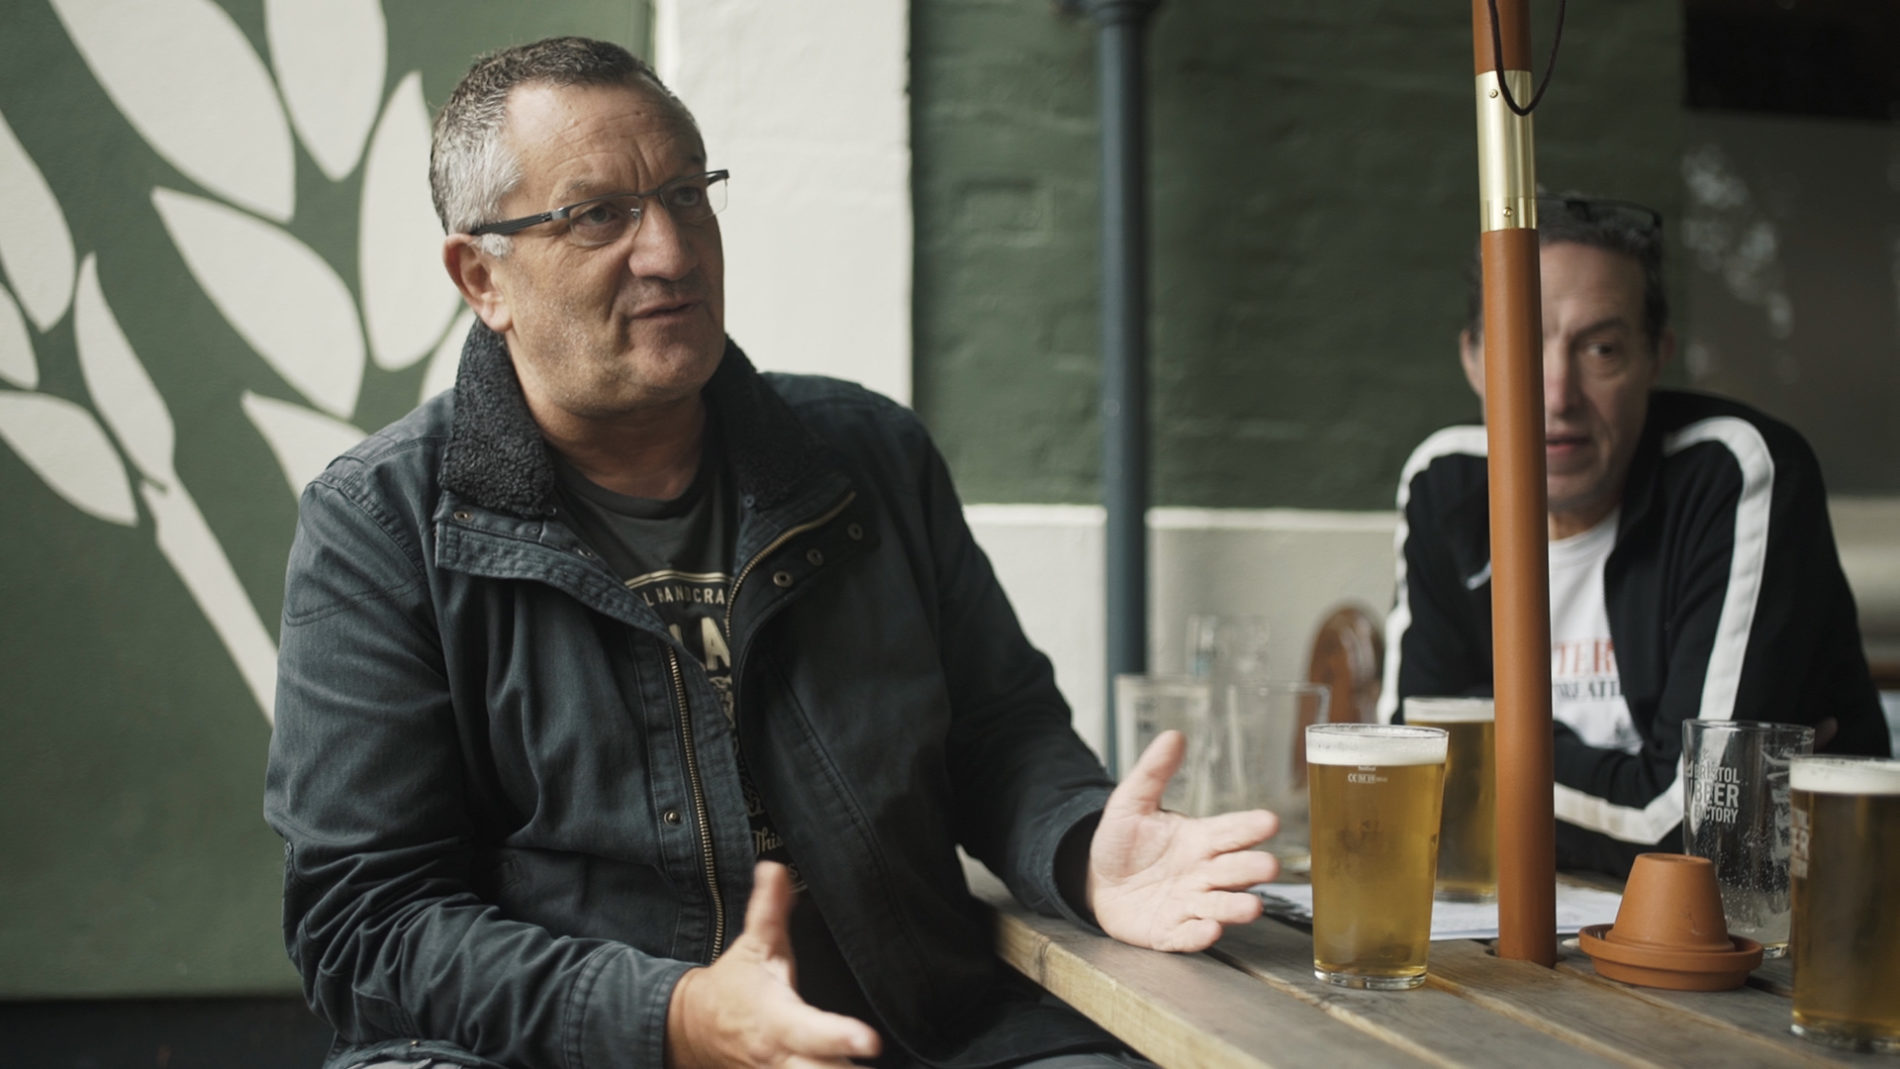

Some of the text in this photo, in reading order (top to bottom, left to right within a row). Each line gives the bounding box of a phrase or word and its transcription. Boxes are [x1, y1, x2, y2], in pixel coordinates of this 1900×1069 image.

[1694, 763, 1740, 784] BRISTOL
[1694, 780, 1739, 809] BEER
[1693, 803, 1739, 824] FACTORY
